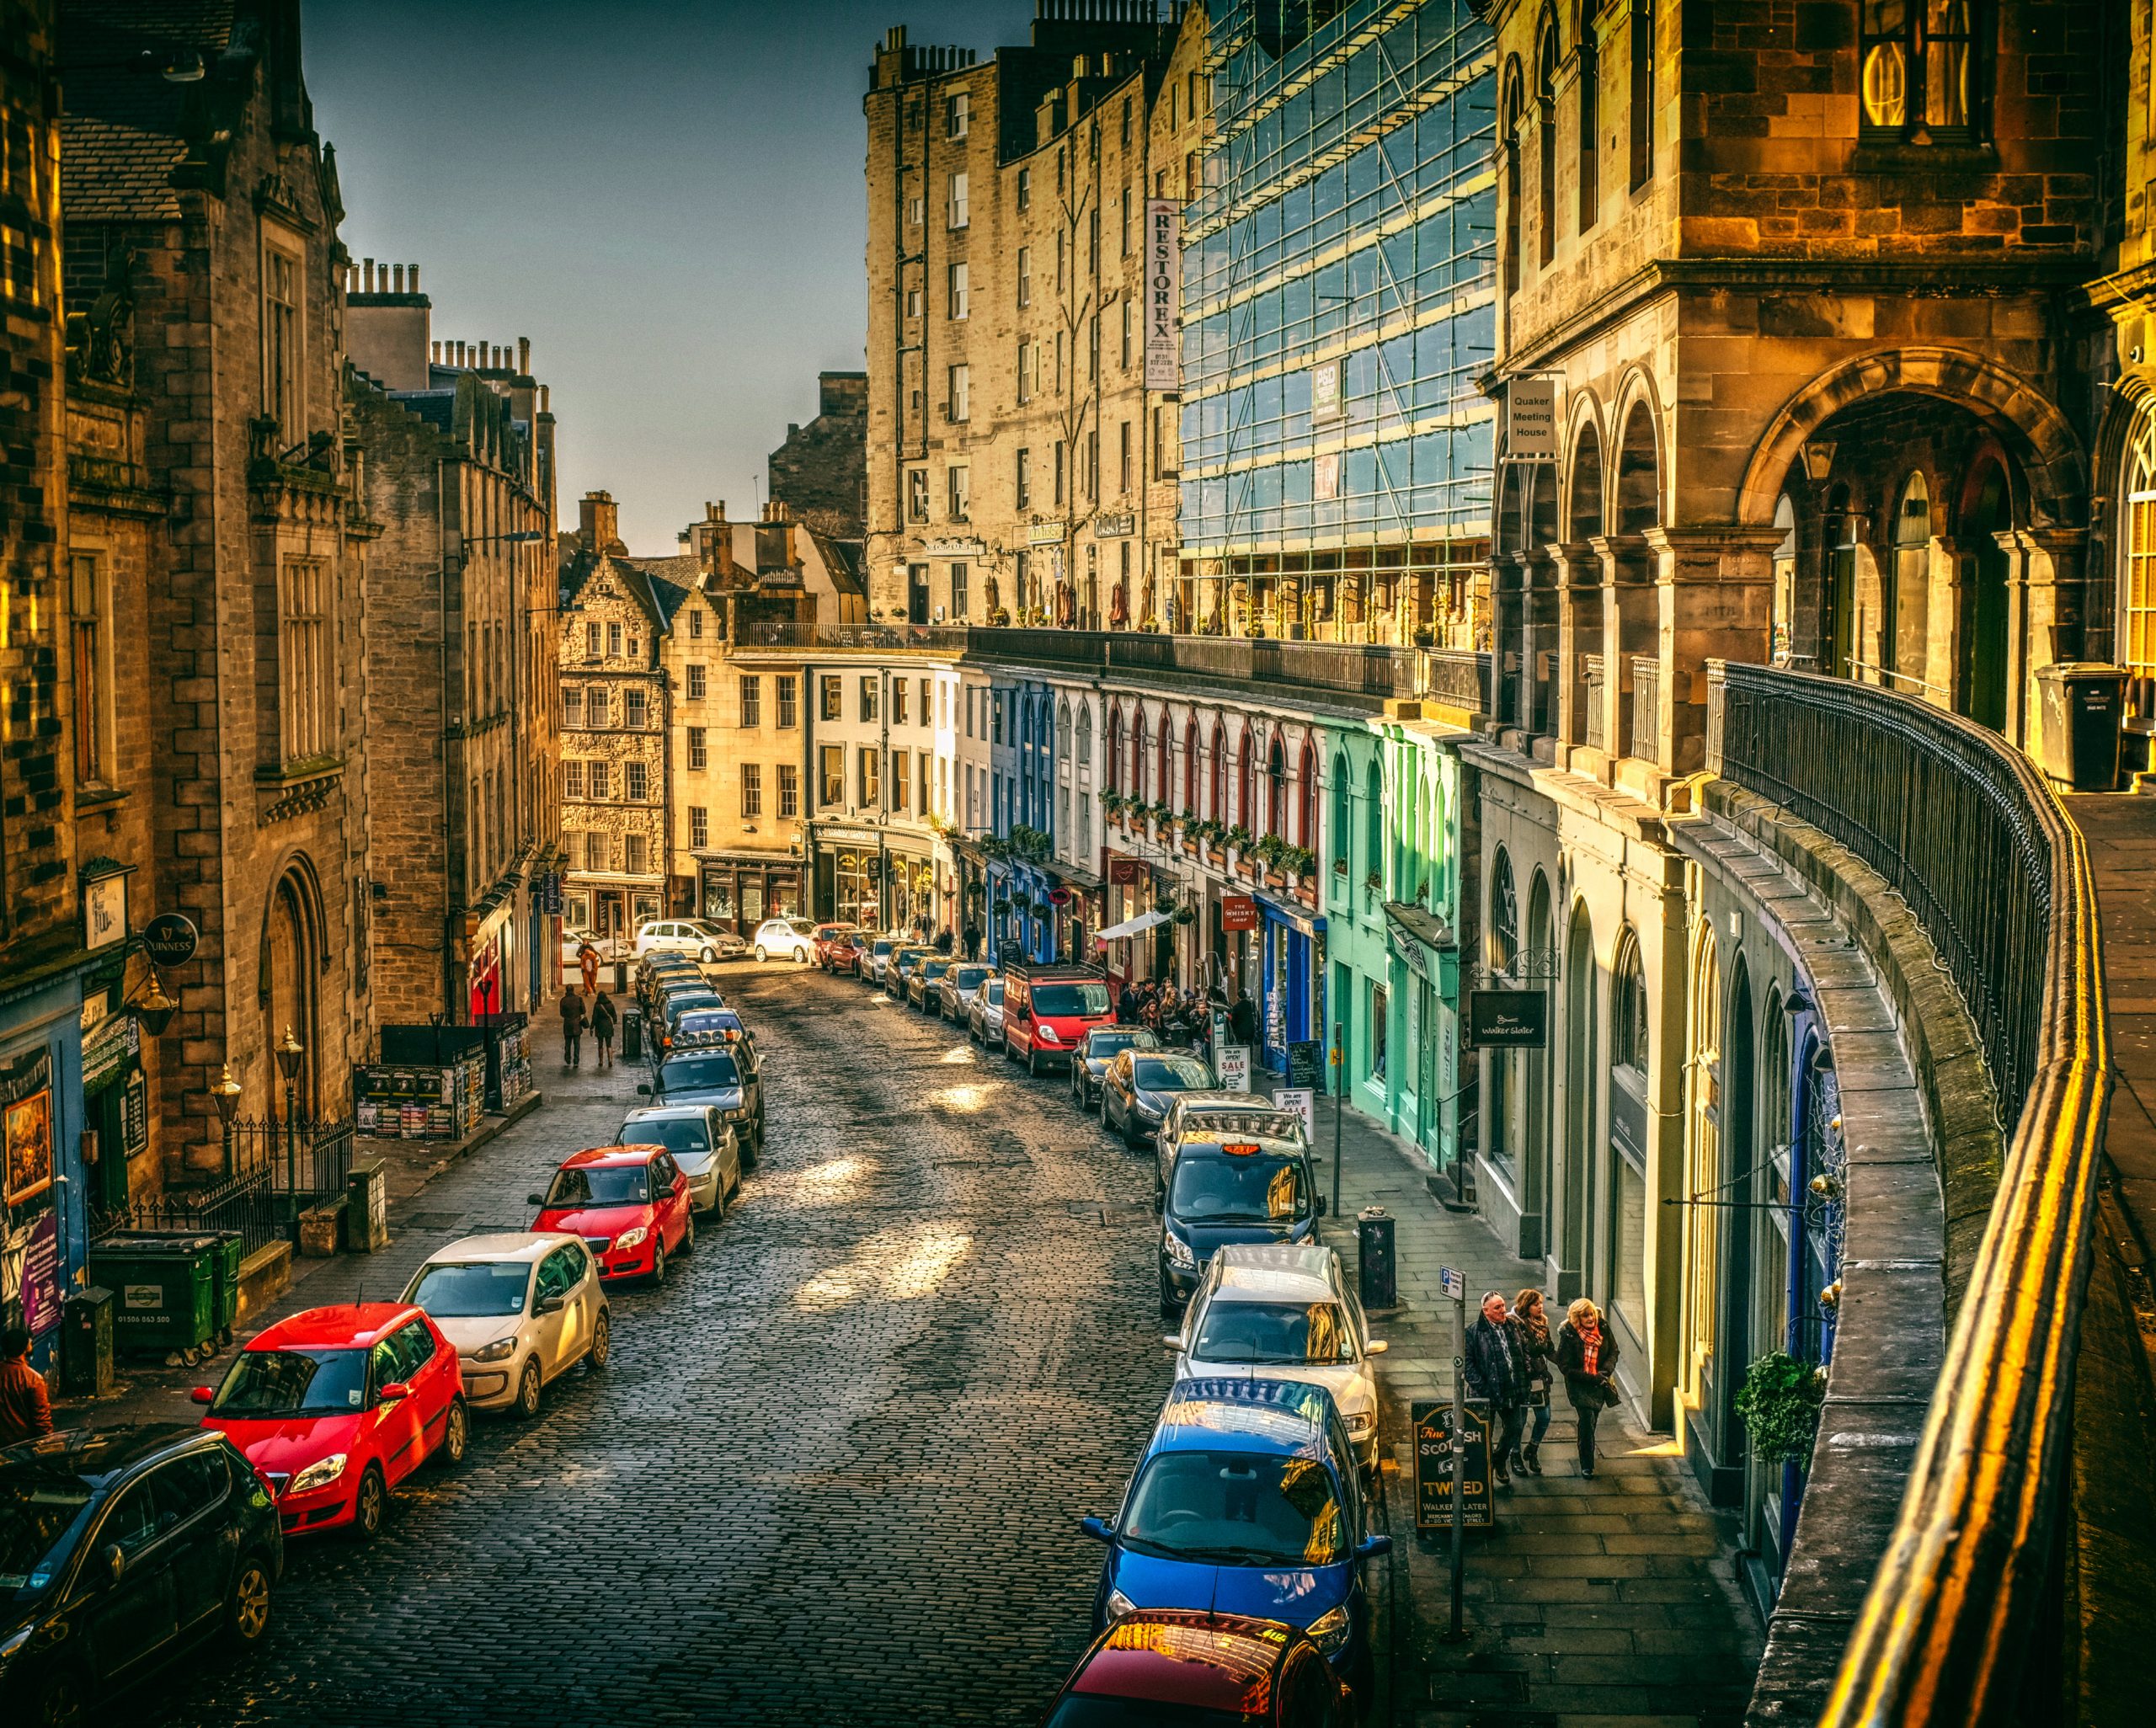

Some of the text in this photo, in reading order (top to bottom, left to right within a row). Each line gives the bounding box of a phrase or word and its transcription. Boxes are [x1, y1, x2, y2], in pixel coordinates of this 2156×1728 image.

[1153, 214, 1171, 338] RESTOREX
[1514, 397, 1550, 406] Quaker
[1513, 413, 1551, 423] Meeting
[1516, 428, 1547, 436] House
[1217, 1013, 1223, 1022] P
[1221, 1061, 1245, 1069] SALE
[1443, 1270, 1449, 1283] P
[1420, 1427, 1445, 1439] Fine
[1419, 1431, 1482, 1456] SCOTSH
[1422, 1480, 1484, 1496] TWED
